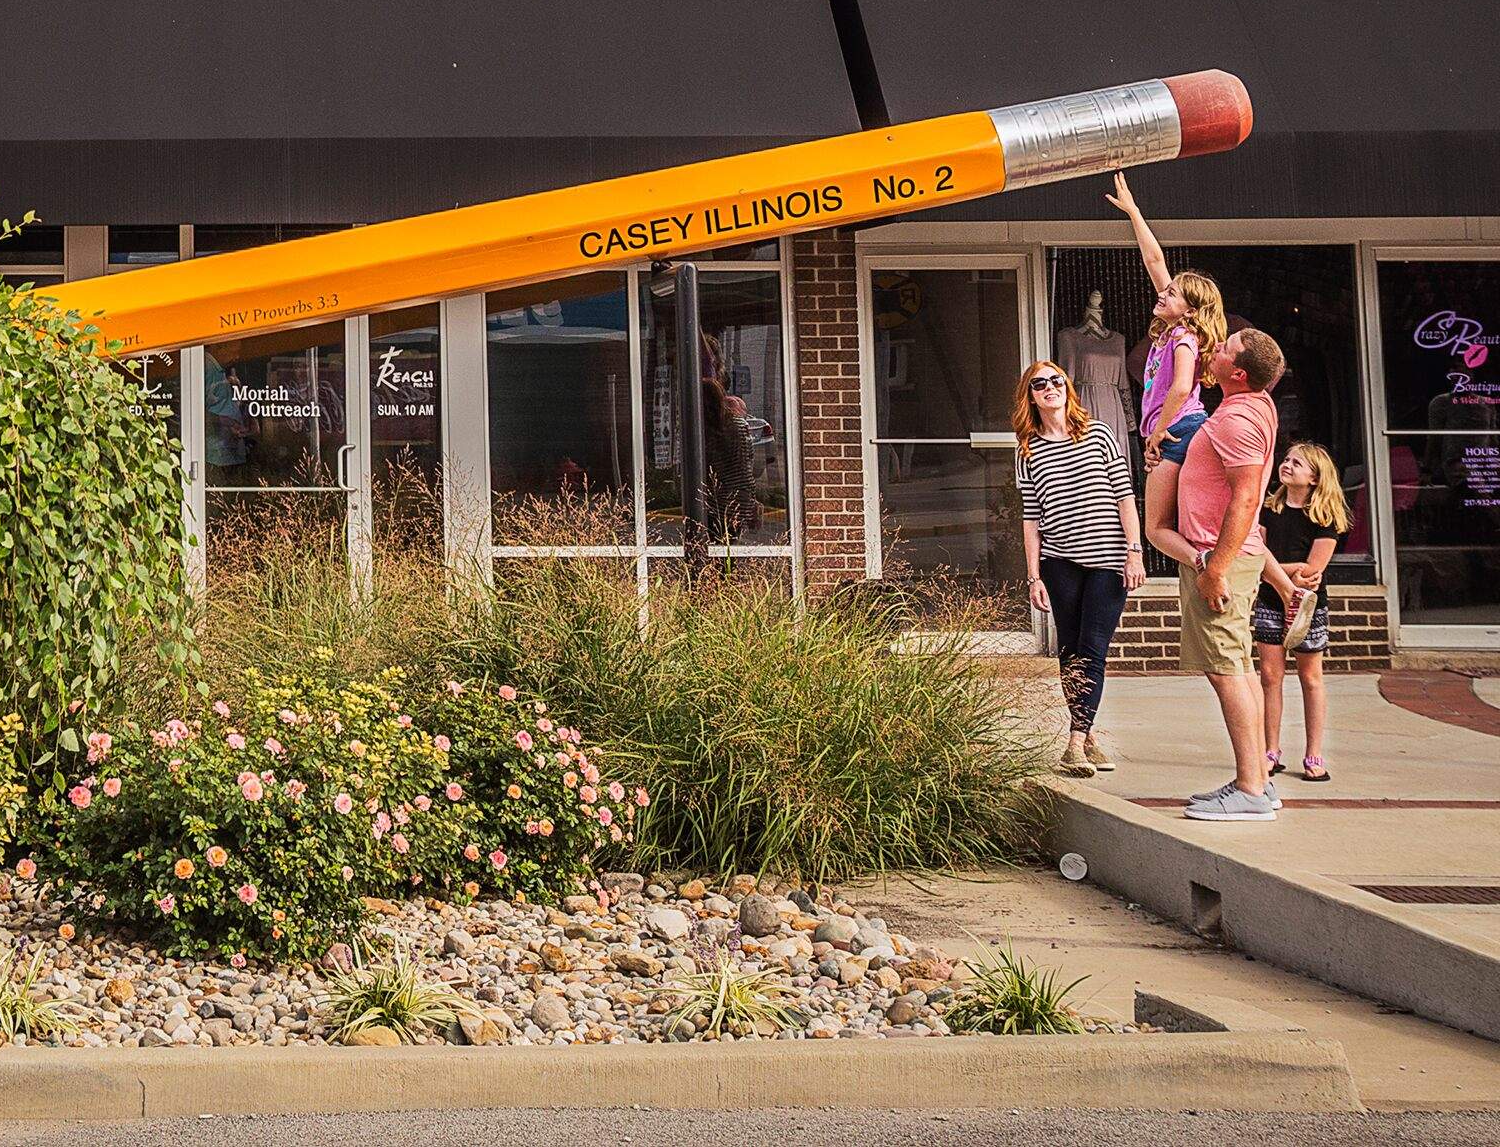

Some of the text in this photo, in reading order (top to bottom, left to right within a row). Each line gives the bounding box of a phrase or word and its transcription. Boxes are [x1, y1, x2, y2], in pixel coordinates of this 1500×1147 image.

[580, 166, 954, 258] CASEY ILLINOIS No. 2
[219, 293, 339, 328] NIV Proverbs 3:3
[376, 346, 434, 392] REACH
[231, 385, 290, 401] Moriah
[128, 405, 145, 416] ED.
[248, 401, 321, 417] Outreach
[377, 404, 434, 416] SUN. 10 AM
[1465, 447, 1500, 456] HOURS
